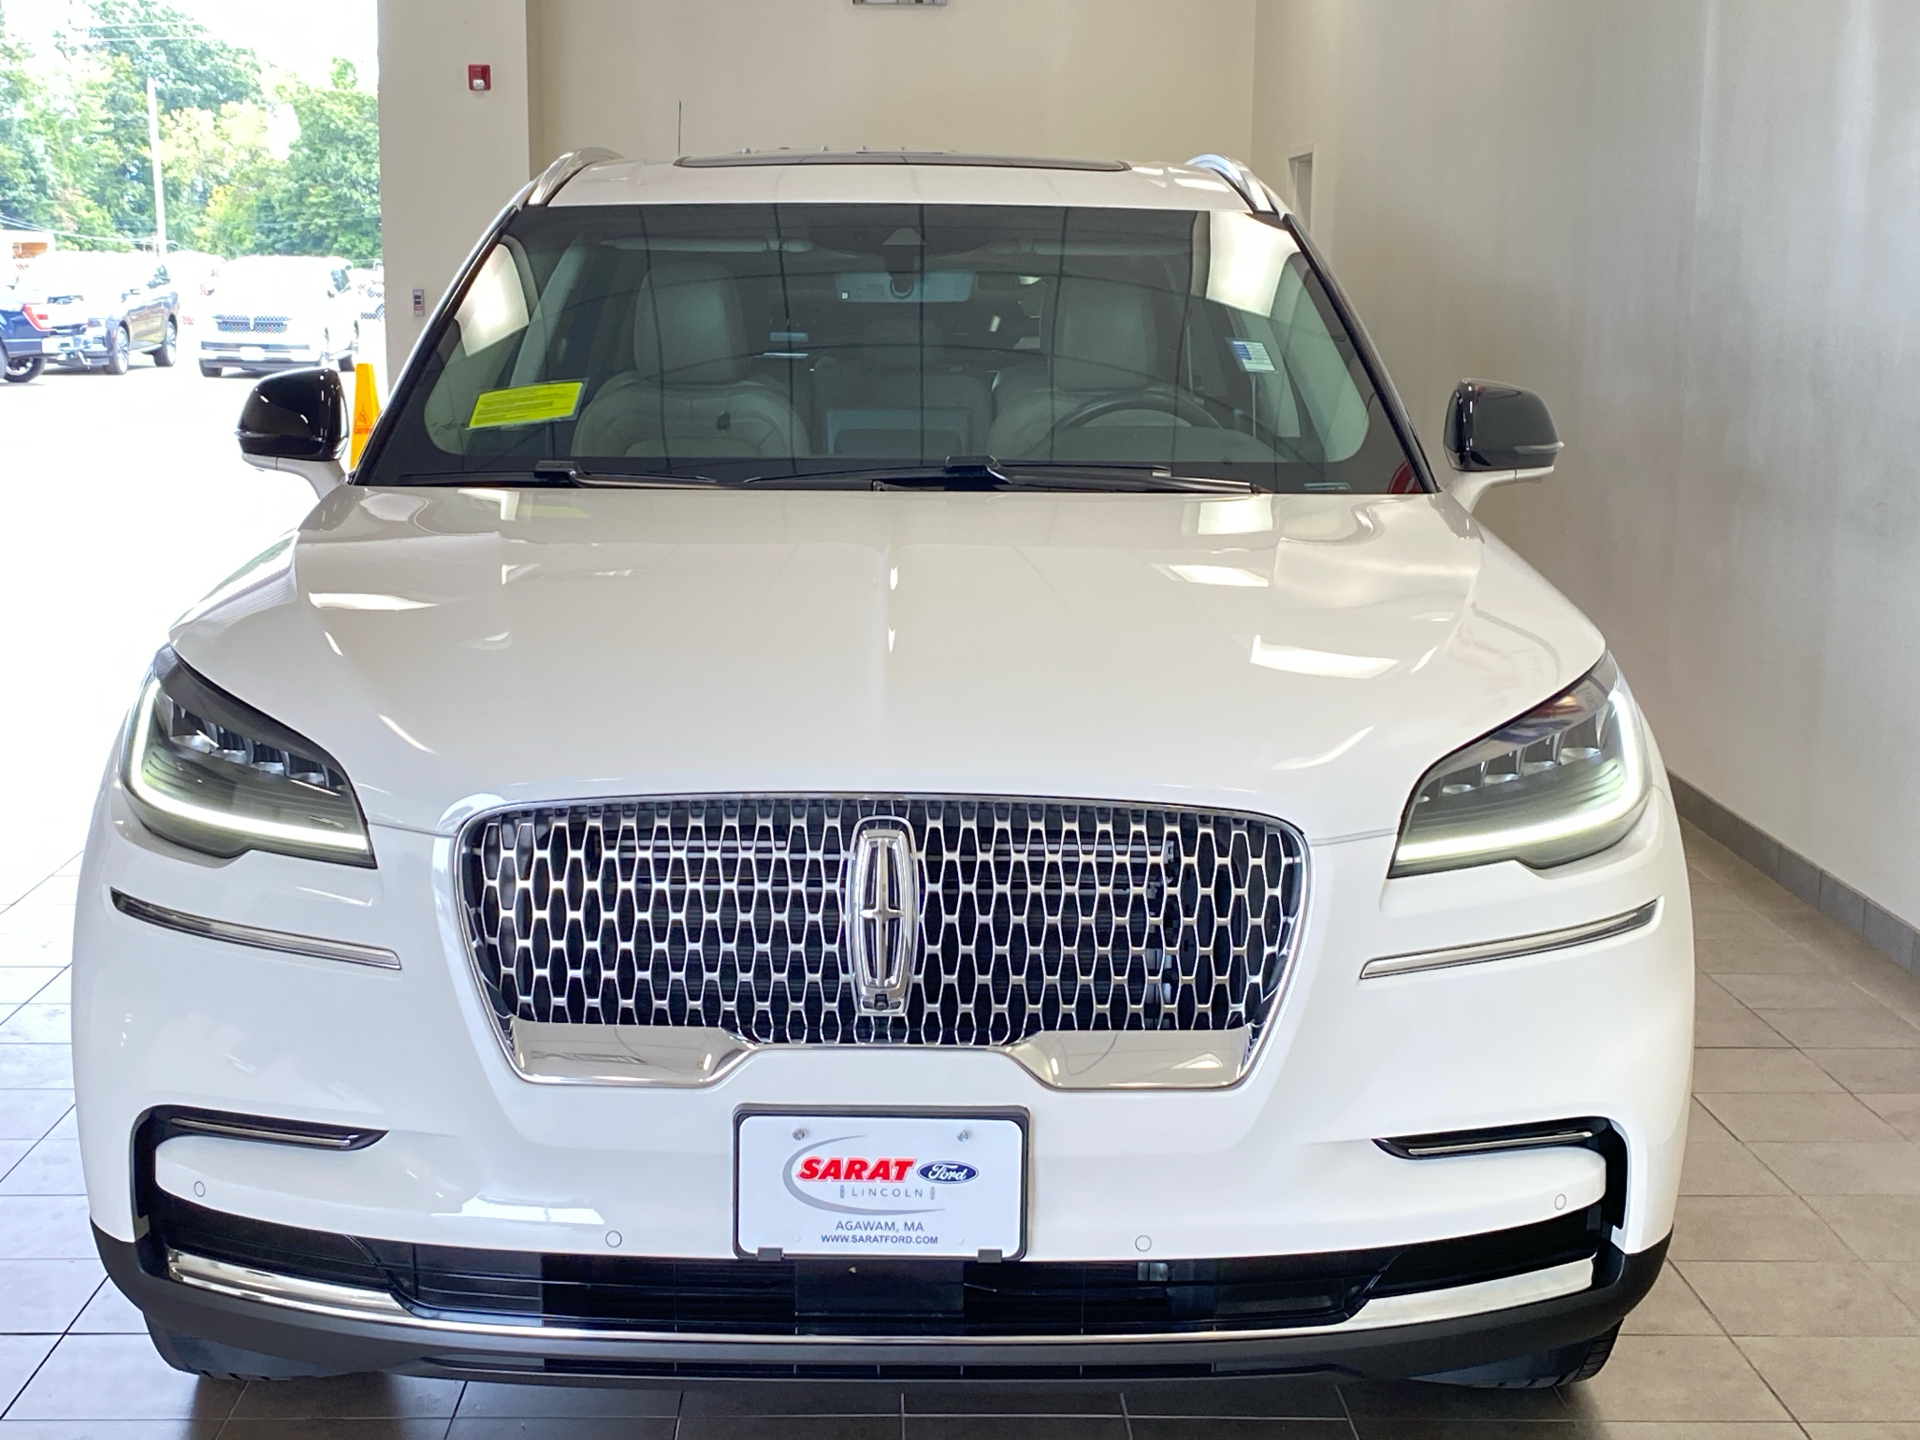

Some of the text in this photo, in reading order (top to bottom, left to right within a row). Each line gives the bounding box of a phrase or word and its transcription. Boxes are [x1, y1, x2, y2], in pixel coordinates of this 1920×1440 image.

[797, 1157, 967, 1182] SARAT Ford
[852, 1188, 923, 1198] LINCOLN
[835, 1220, 925, 1233] AGAWAM, MA
[821, 1234, 938, 1244] WWW.SARATFORD.COM
